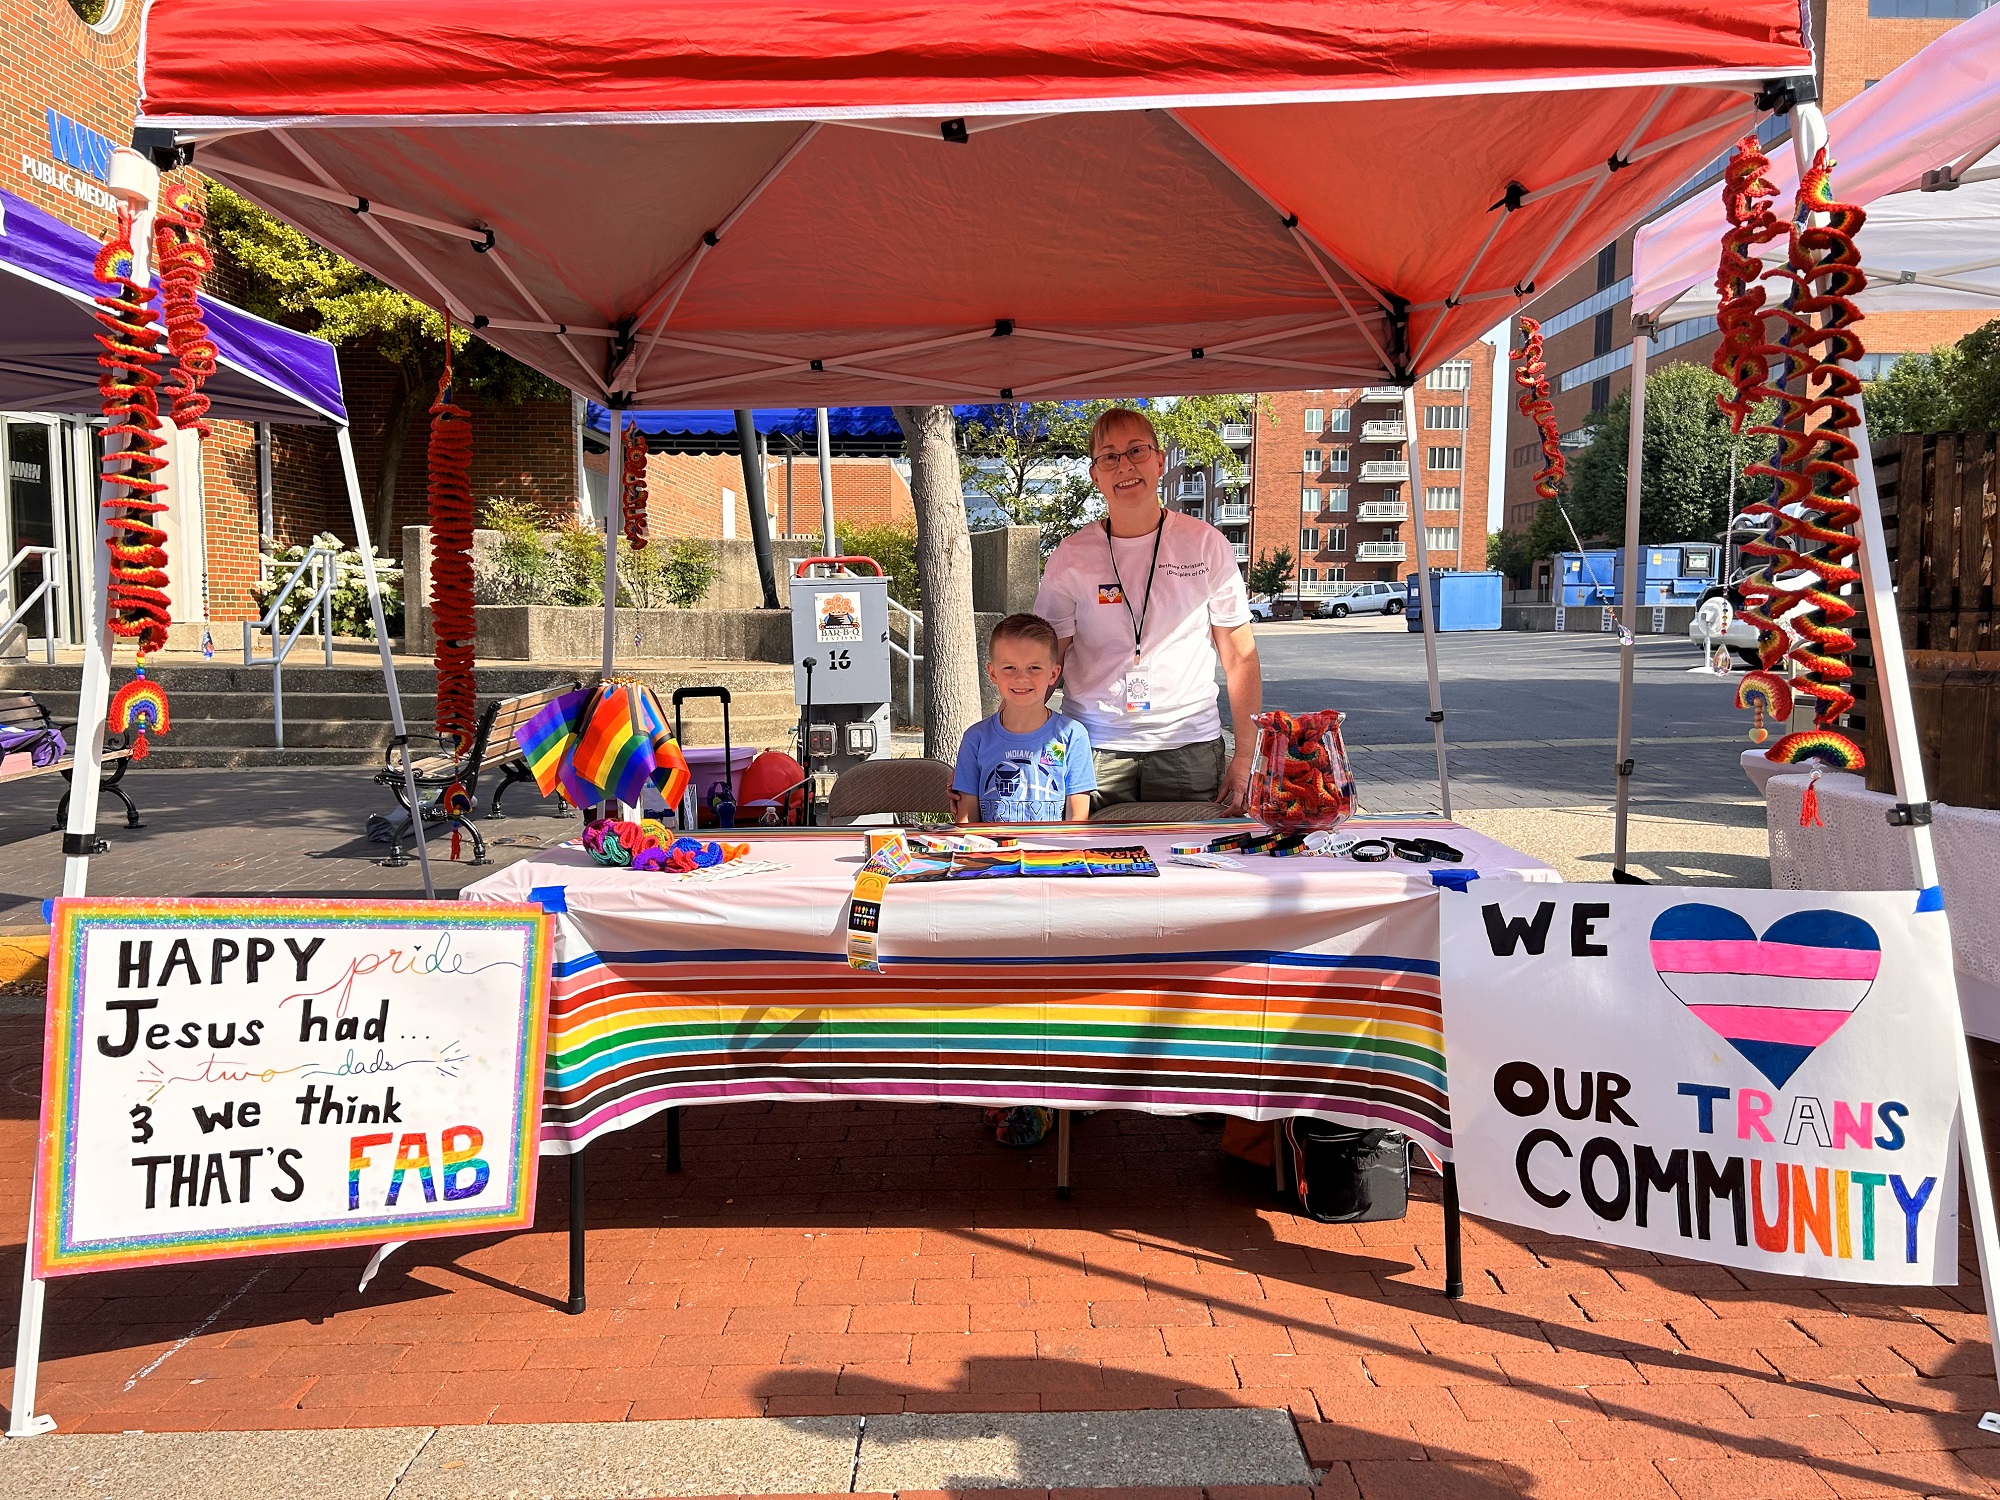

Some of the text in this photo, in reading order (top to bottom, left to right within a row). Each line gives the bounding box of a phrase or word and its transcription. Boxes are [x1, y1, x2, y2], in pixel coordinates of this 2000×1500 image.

[22, 154, 118, 217] PUBLIC MEDIA
[821, 628, 860, 637] BAR-B-Q
[829, 650, 851, 670] 16
[1005, 750, 1034, 759] INDIANA
[1481, 901, 1610, 957] WE
[117, 931, 523, 1018] HAPPY pride
[97, 998, 265, 1057] Jesus
[192, 1100, 261, 1135] we
[297, 1084, 403, 1125] think
[1493, 1060, 1910, 1151] OUR TRANS
[131, 1124, 490, 1211] THAT'S FAB
[1515, 1128, 1937, 1263] COMMUNITY
